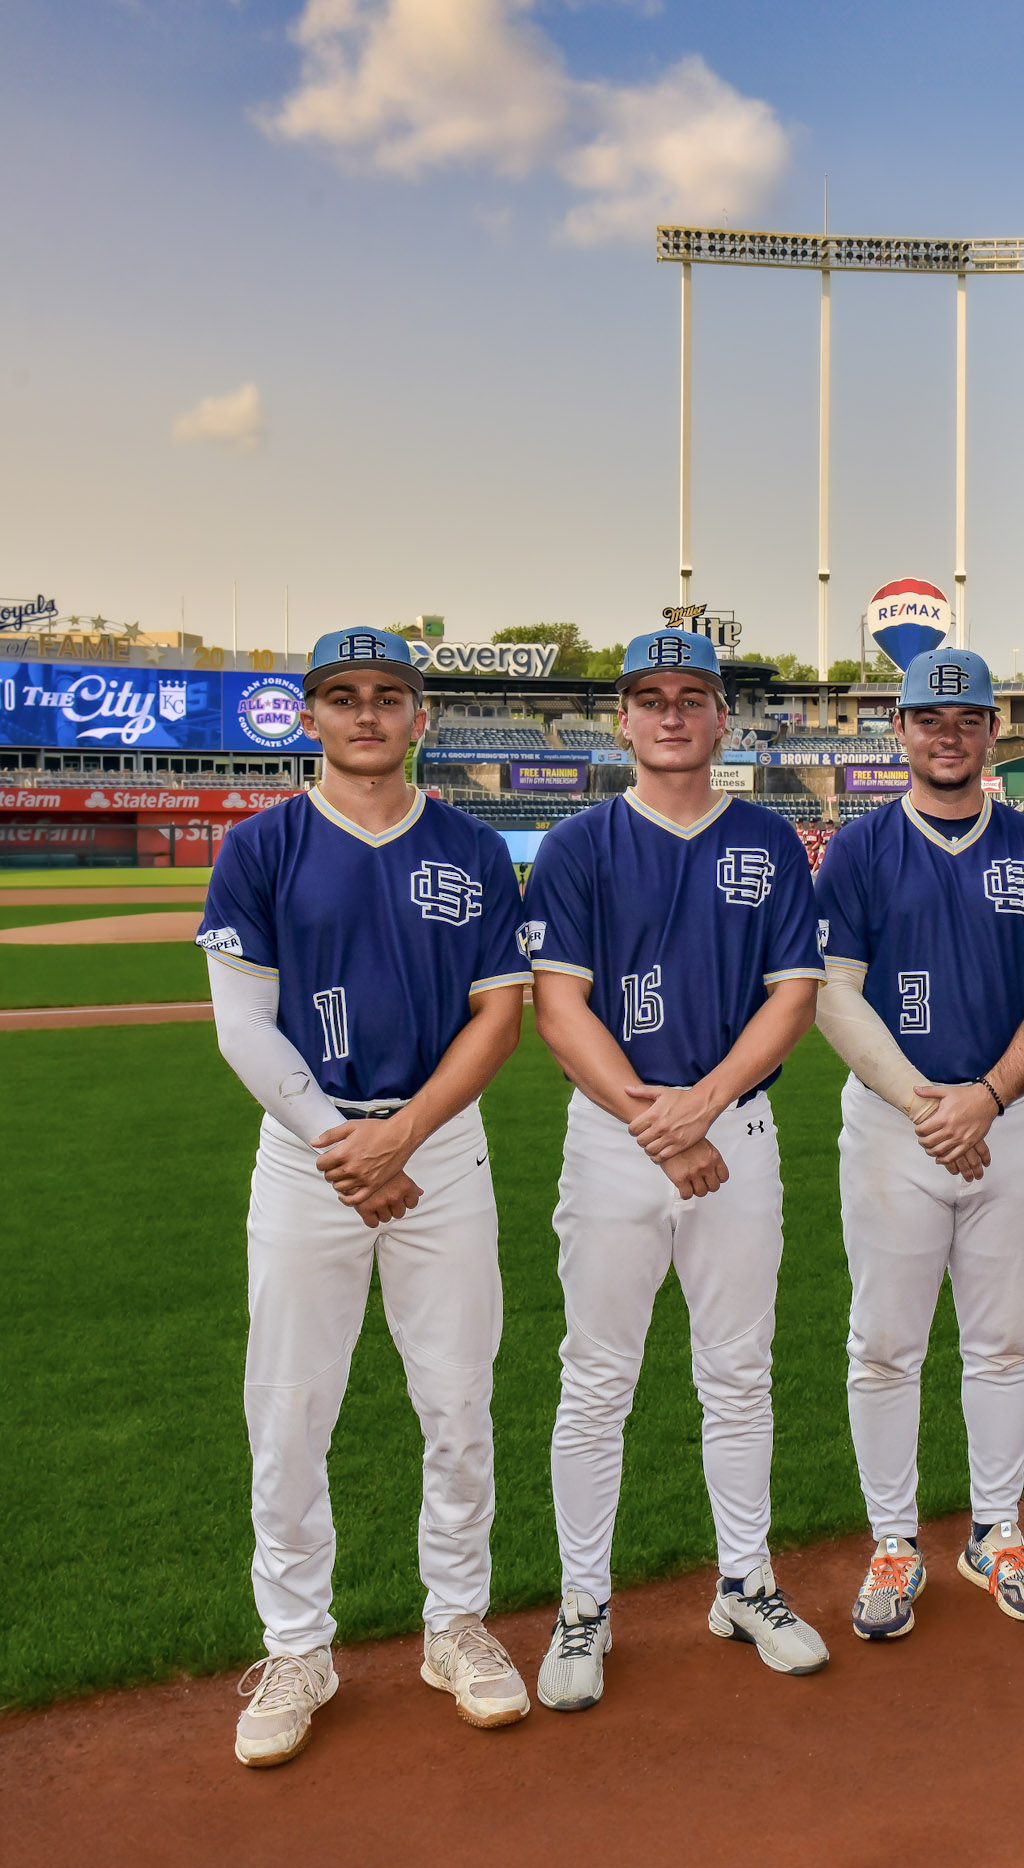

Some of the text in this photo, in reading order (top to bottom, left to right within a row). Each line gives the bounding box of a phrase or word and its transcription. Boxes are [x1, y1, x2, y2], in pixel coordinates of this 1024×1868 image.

[0, 594, 56, 630] oyals
[662, 603, 707, 628] Miller
[878, 603, 941, 621] RE/MAX
[6, 633, 131, 660] of FAME
[195, 647, 224, 668] 20
[249, 649, 274, 671] 10
[436, 643, 559, 677] evergy
[241, 681, 260, 697] BAN
[0, 679, 15, 711] O
[62, 675, 156, 744] City
[237, 698, 265, 713] ALL
[256, 713, 291, 724] GAME
[238, 716, 304, 747] COLLEGIATE LEAG
[780, 754, 820, 765] BROWN
[822, 754, 831, 765] &
[519, 768, 578, 777] FREE TRAINING
[711, 778, 745, 787] fitness
[853, 771, 908, 779] FREE TRAINING
[536, 822, 551, 830] 387
[622, 965, 665, 1041] 16
[898, 971, 931, 1034] 3
[313, 987, 349, 1062] 11
